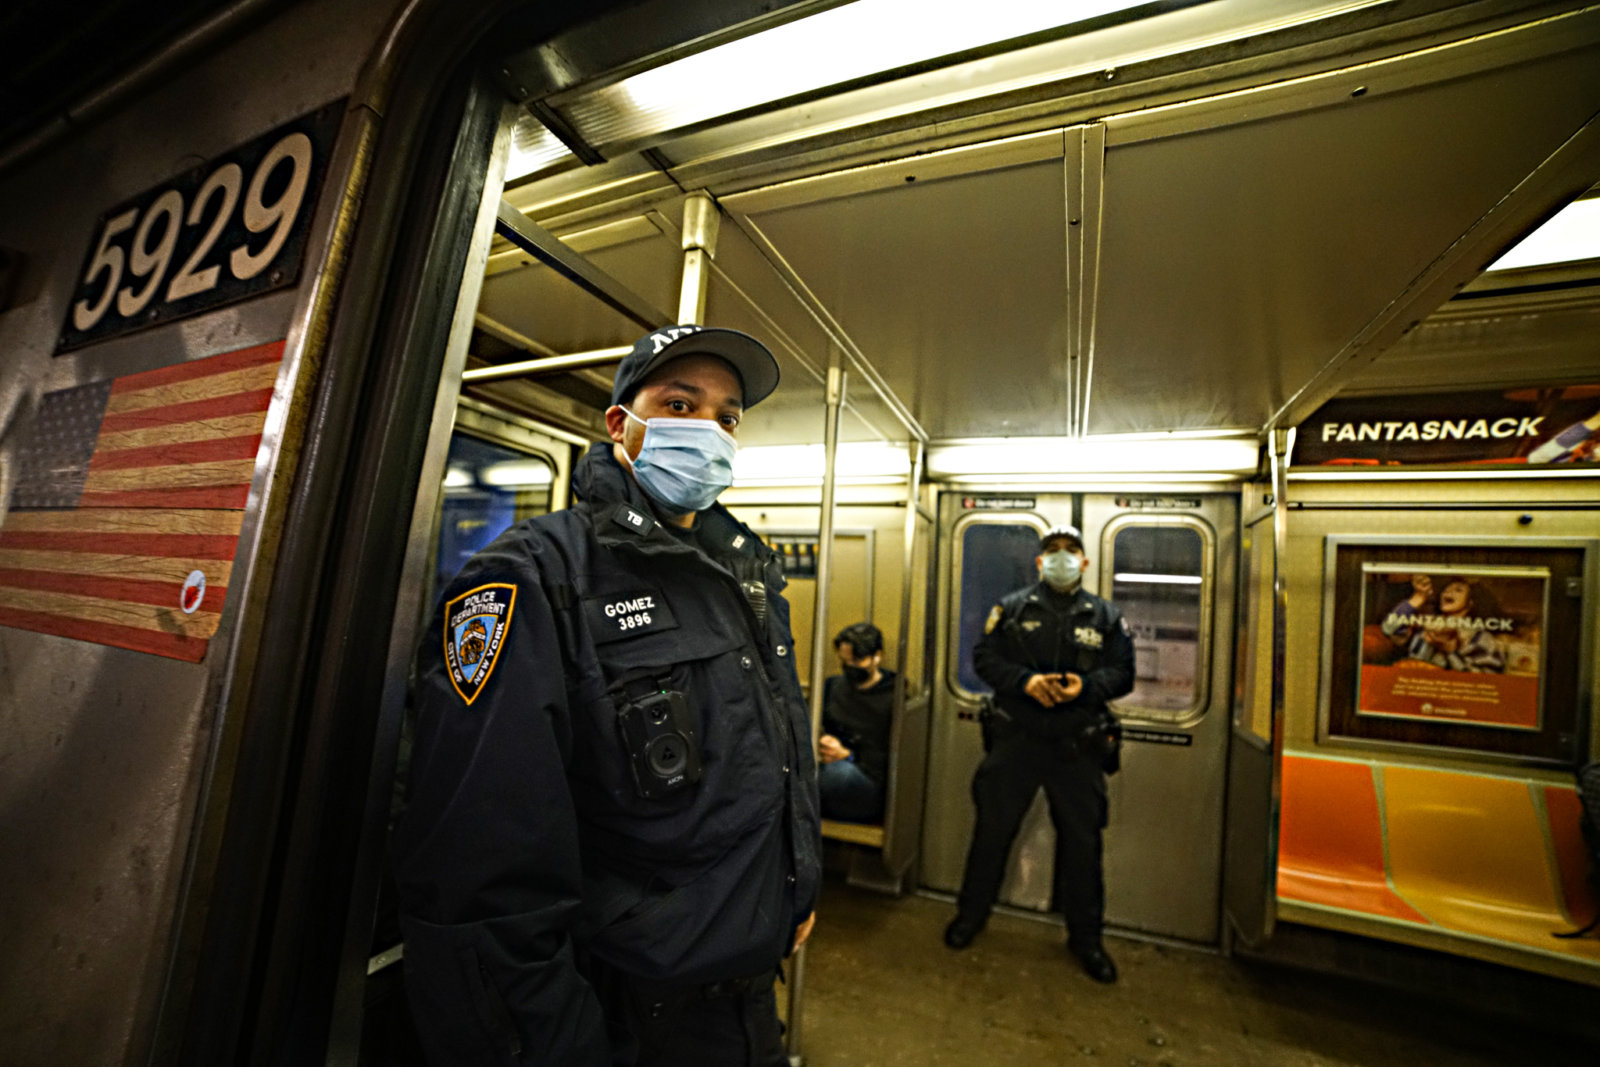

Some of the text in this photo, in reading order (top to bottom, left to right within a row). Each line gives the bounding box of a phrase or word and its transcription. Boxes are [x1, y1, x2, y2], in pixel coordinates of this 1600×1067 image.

[73, 132, 312, 331] 5929
[1322, 416, 1545, 442] FANTASNACK
[464, 591, 496, 609] POLICE
[604, 596, 655, 617] GOMEZ
[618, 612, 652, 630] 3896
[473, 658, 490, 685] NEW
[486, 622, 505, 657] YORK
